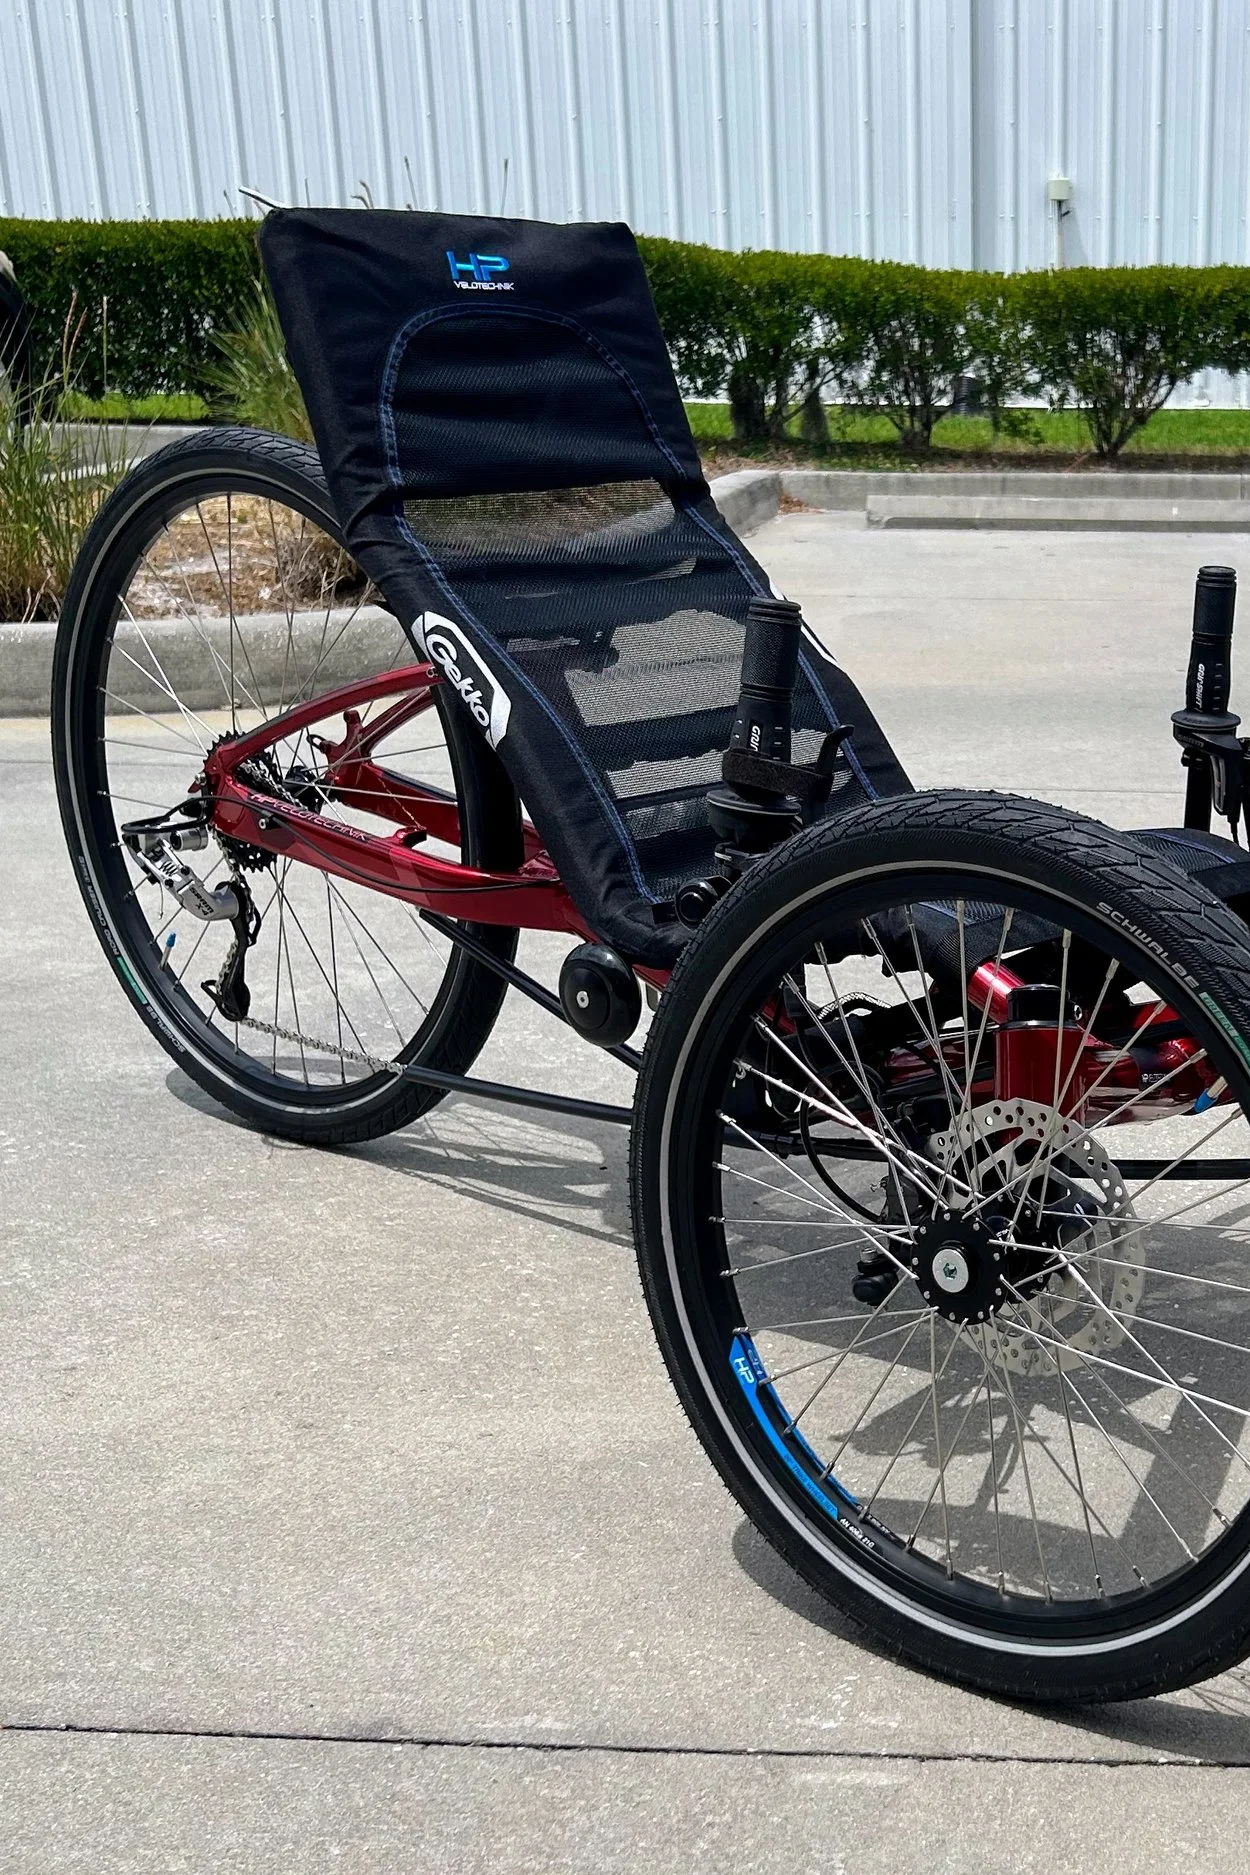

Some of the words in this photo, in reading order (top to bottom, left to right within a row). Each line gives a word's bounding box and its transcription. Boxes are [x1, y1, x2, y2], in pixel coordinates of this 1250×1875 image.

[446, 251, 510, 281] HP
[453, 280, 515, 291] VELOTECHNIK
[426, 633, 490, 727] Gekko
[87, 885, 107, 927] CRUISER
[189, 887, 215, 914] SRAM
[104, 928, 120, 956] ROAD
[1096, 901, 1200, 989] SCHWALBE
[146, 1005, 186, 1053] SCHWALBE
[734, 1356, 755, 1384] HP
